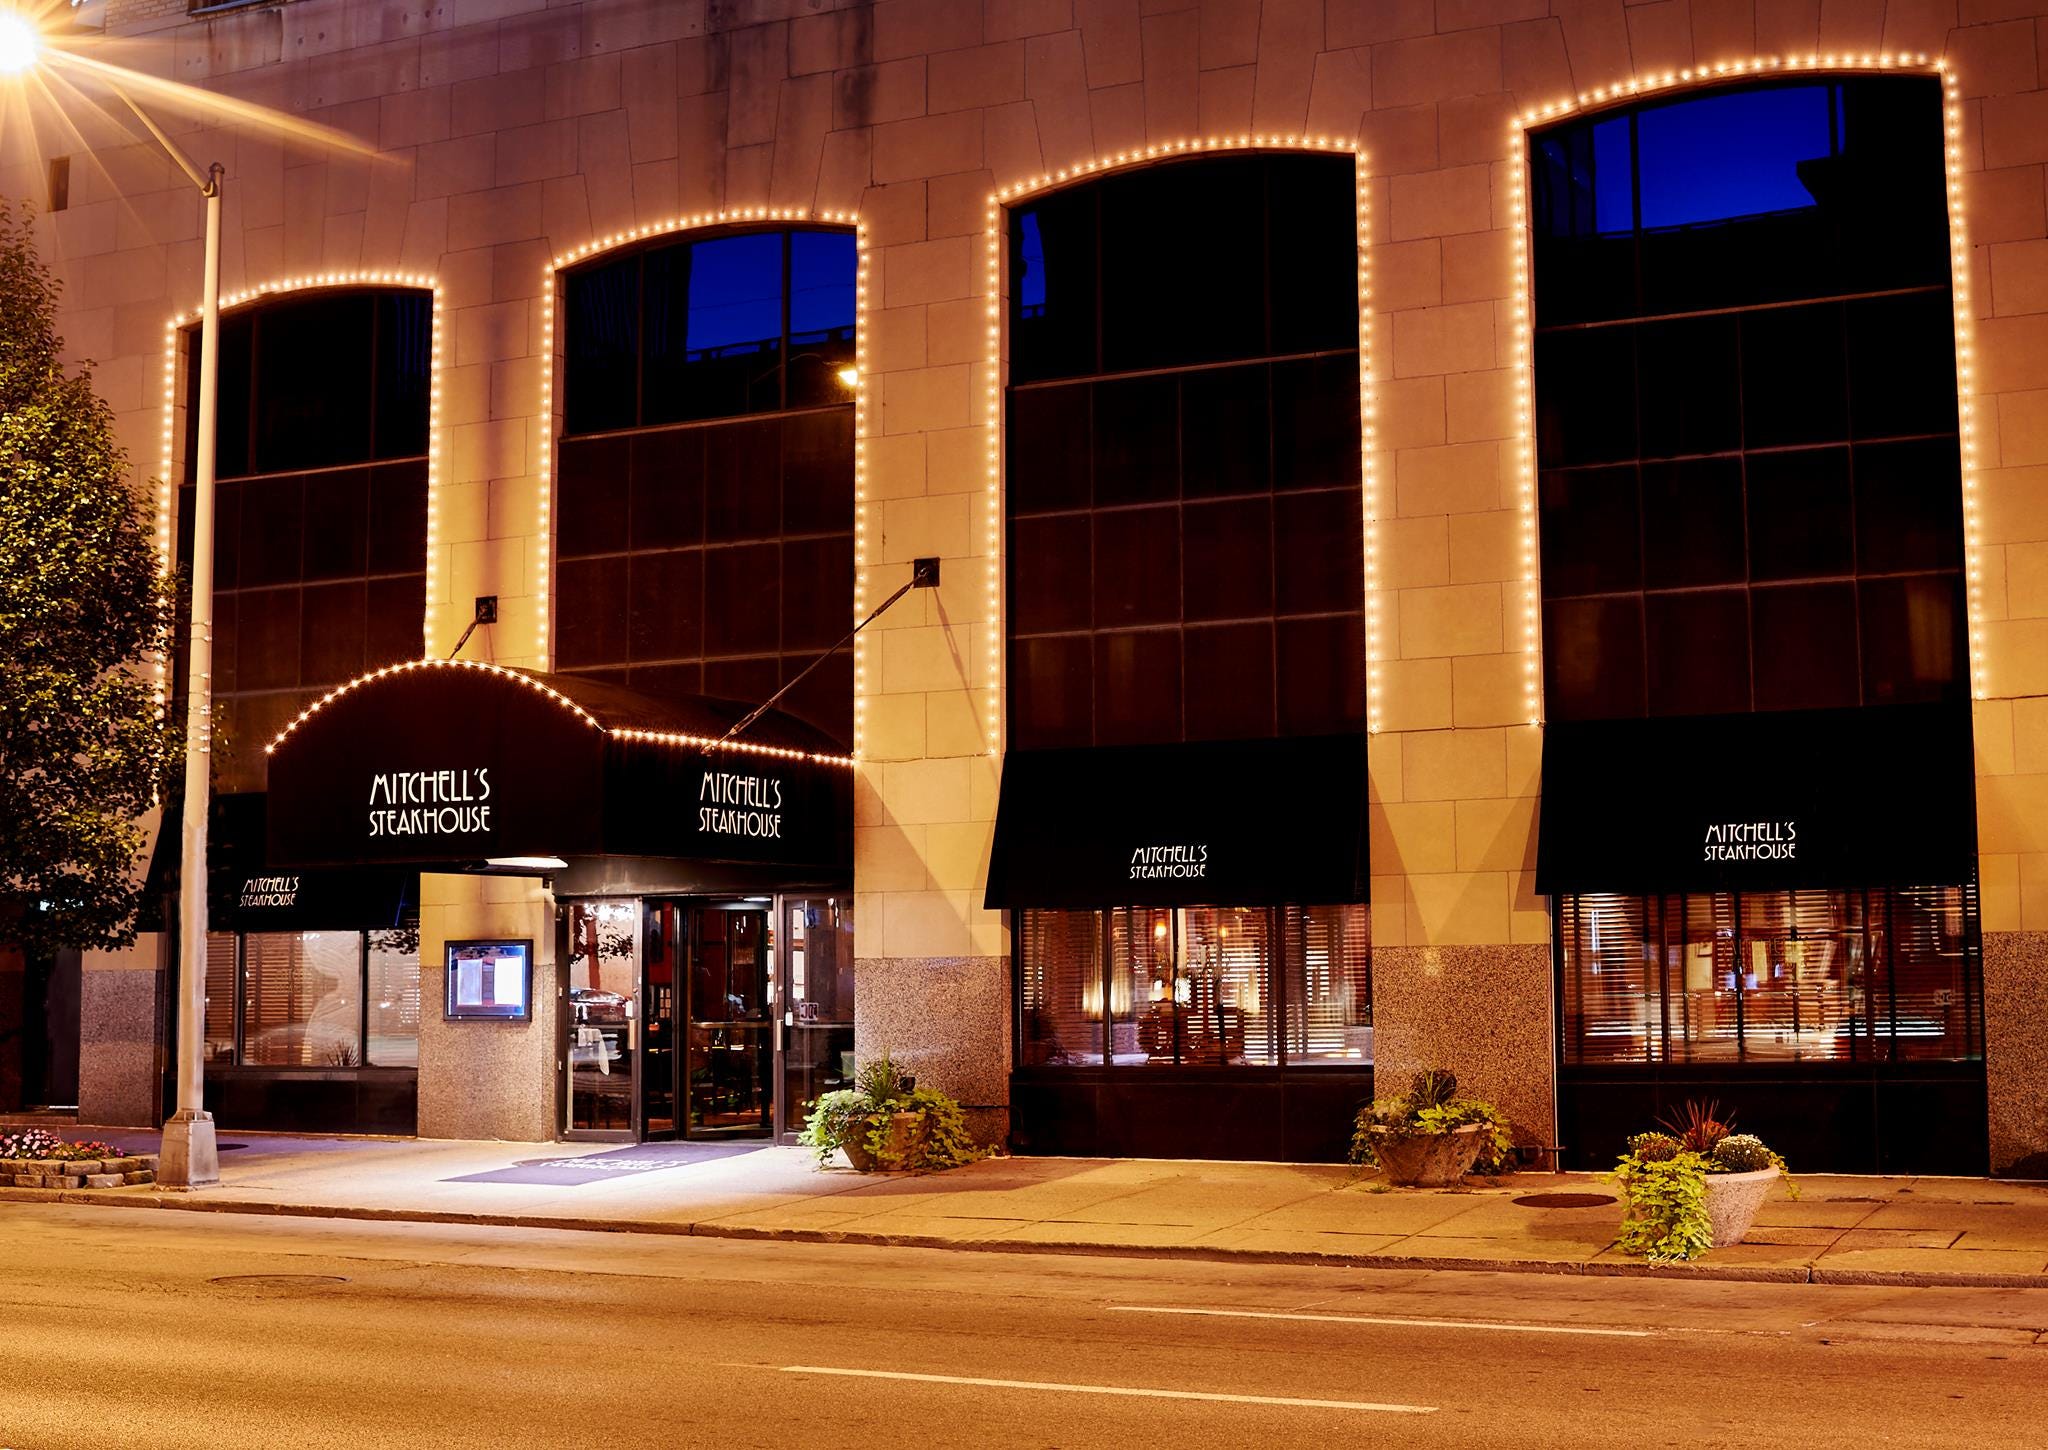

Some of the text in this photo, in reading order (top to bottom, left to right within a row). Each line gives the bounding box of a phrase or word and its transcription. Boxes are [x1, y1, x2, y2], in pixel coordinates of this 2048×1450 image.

[369, 767, 491, 806] MITCHELL'S
[699, 771, 782, 810] MITCHELL'S
[369, 805, 491, 837] STEAKHOUSE
[698, 806, 781, 839] STEAKHOUSE
[1704, 821, 1796, 844] MITCHELL'S
[1131, 844, 1208, 864] MITCHELL'S
[1703, 843, 1796, 862] STEAKHOUSE
[1129, 864, 1206, 880] STEAKHOUSE
[242, 876, 300, 893] MITCHELL'S
[239, 893, 297, 907] STEAKHOUSE
